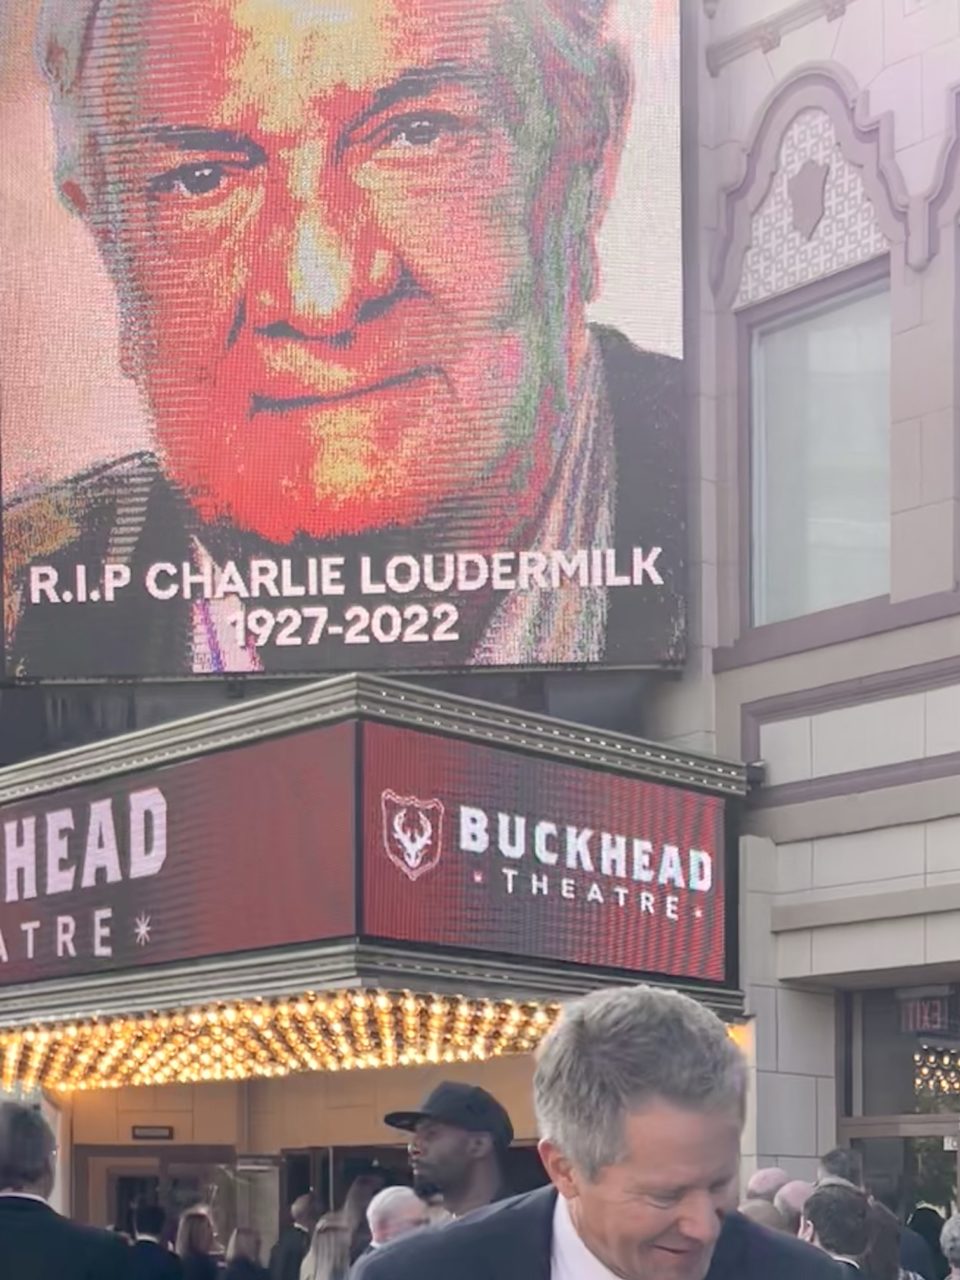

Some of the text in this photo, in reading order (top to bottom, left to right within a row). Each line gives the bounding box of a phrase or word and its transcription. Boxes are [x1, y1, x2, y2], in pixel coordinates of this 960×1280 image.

[29, 546, 665, 604] R.I.P CHARLIE LOUDERMILK
[229, 603, 460, 648] 1927-2022
[459, 806, 712, 893] BUCKHEAD
[502, 868, 679, 921] THEATRE
